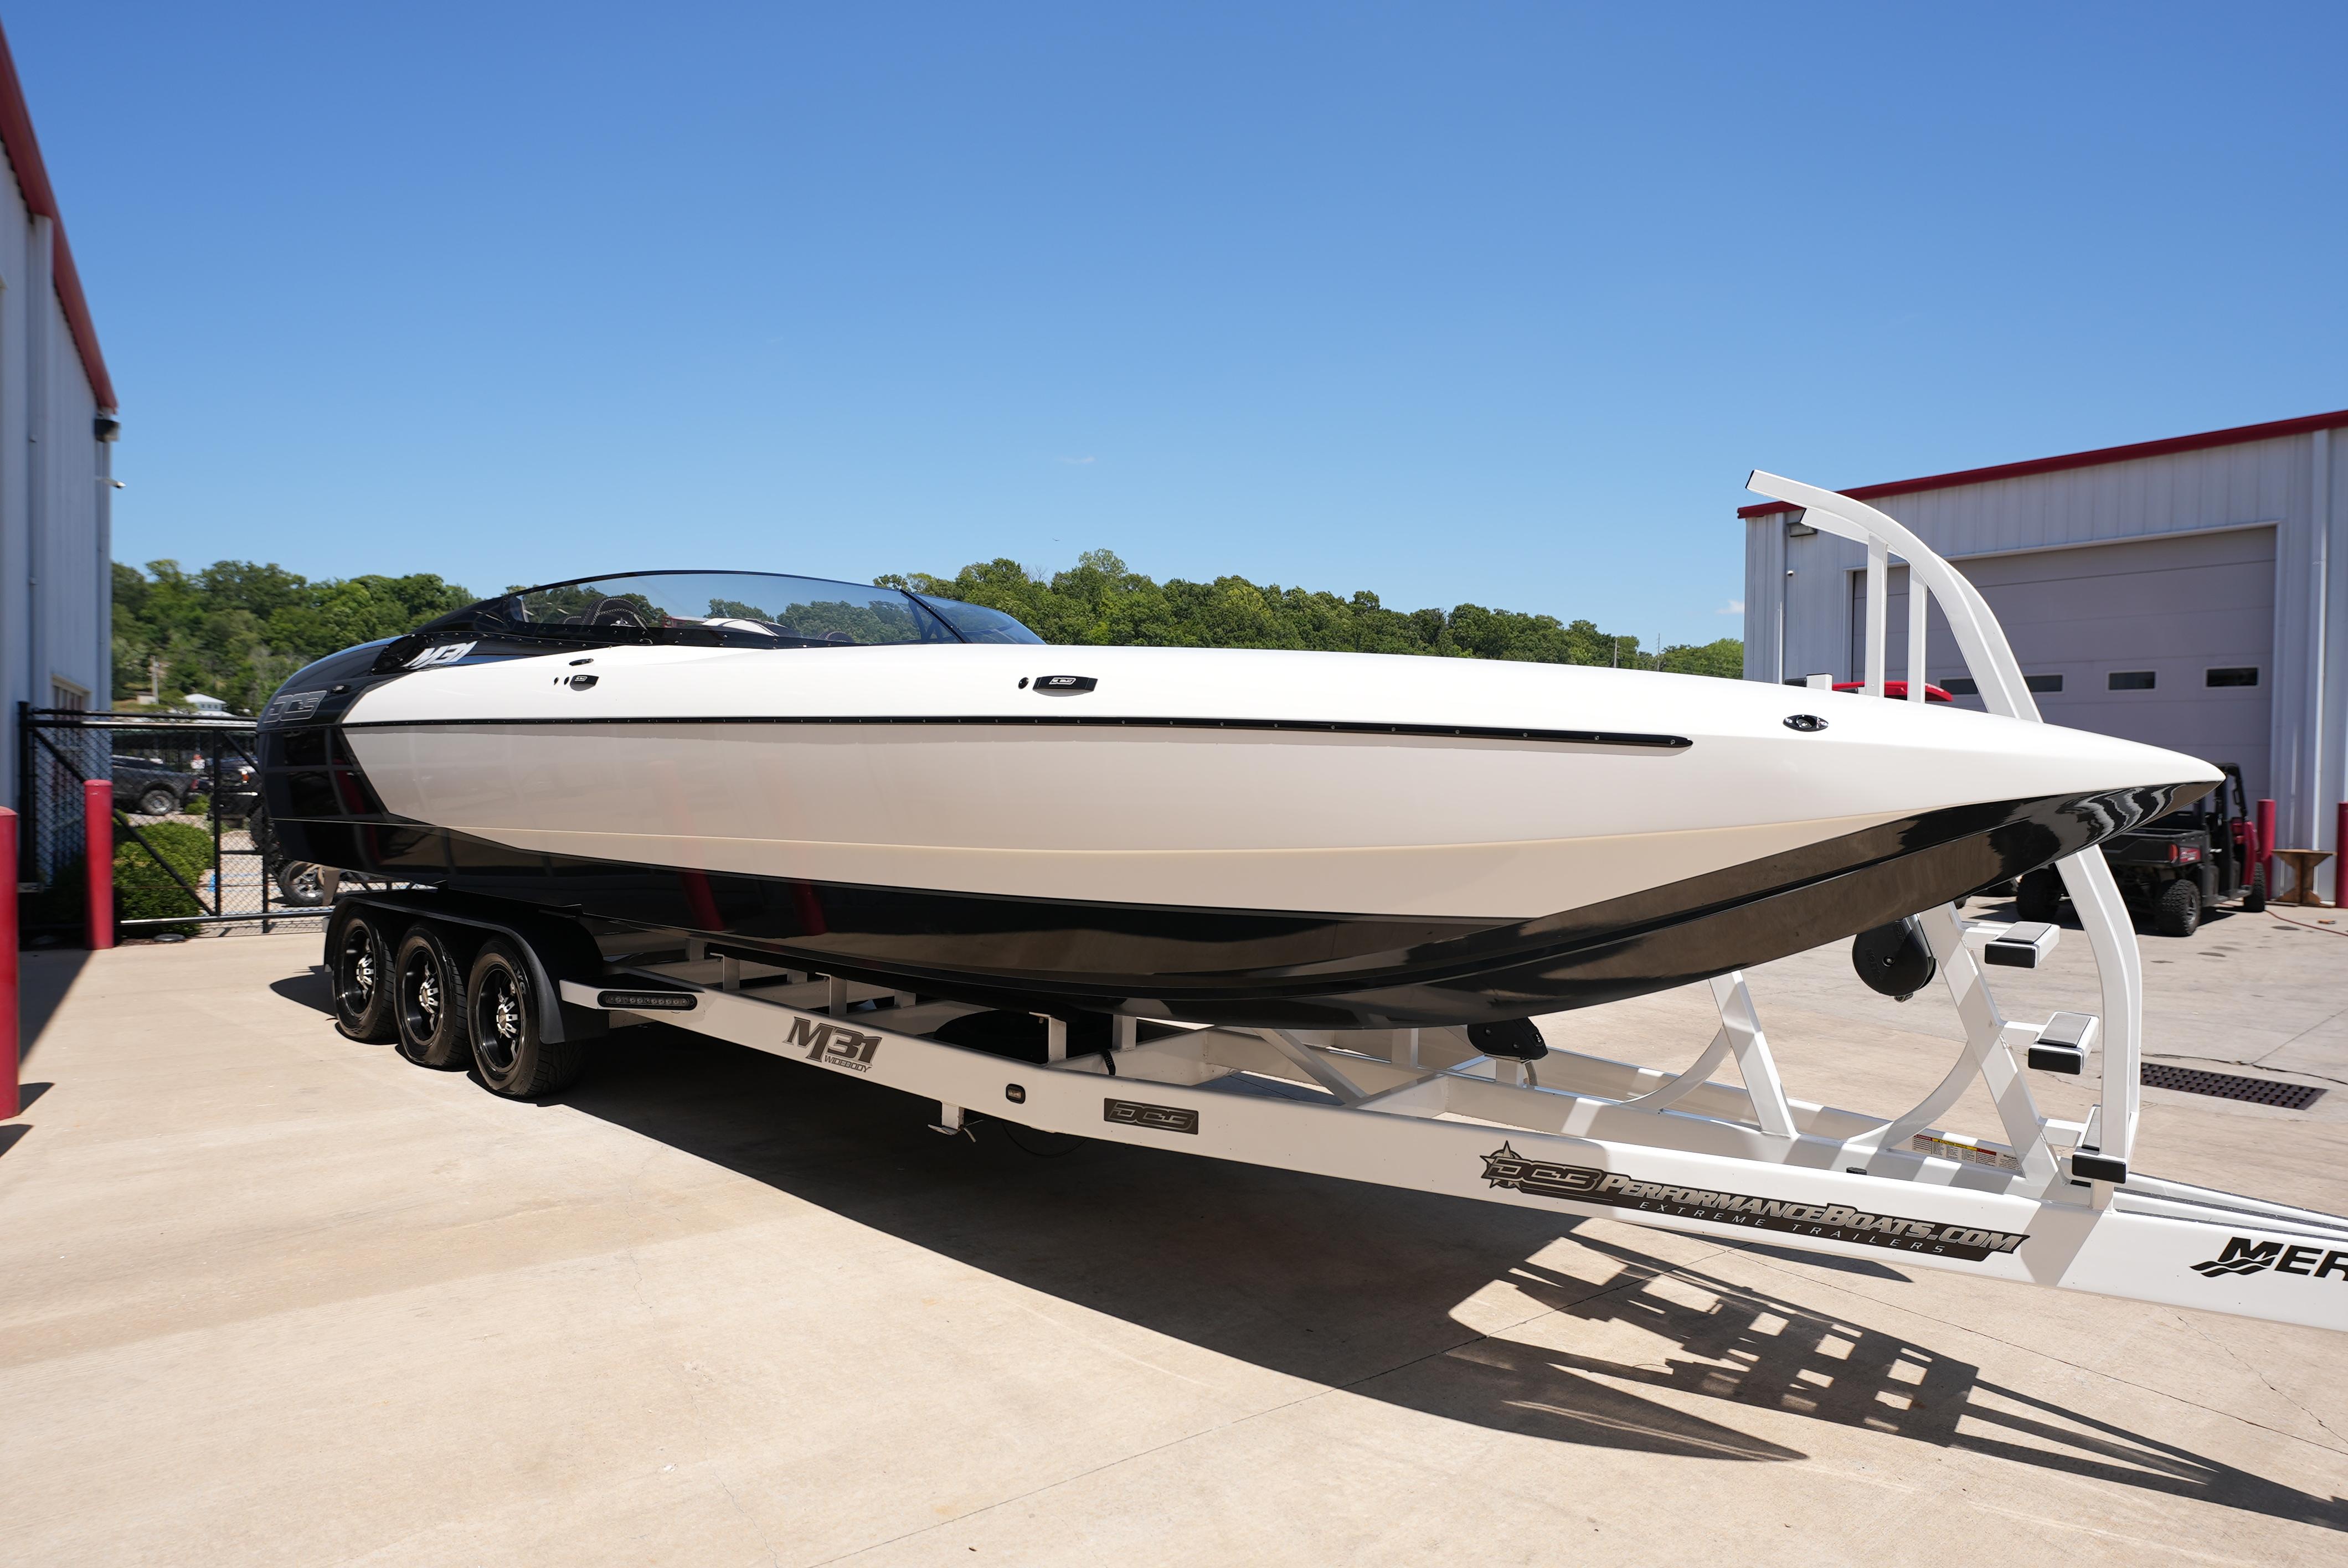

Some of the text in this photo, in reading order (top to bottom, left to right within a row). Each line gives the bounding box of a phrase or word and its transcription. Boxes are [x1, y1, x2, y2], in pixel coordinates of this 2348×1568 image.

[400, 640, 478, 670] M31
[782, 1016, 883, 1066] M31
[824, 1055, 873, 1073] WIDEBODY
[1108, 1101, 1196, 1131] DCB
[1639, 1201, 1945, 1254] EXTREME TRAILERS
